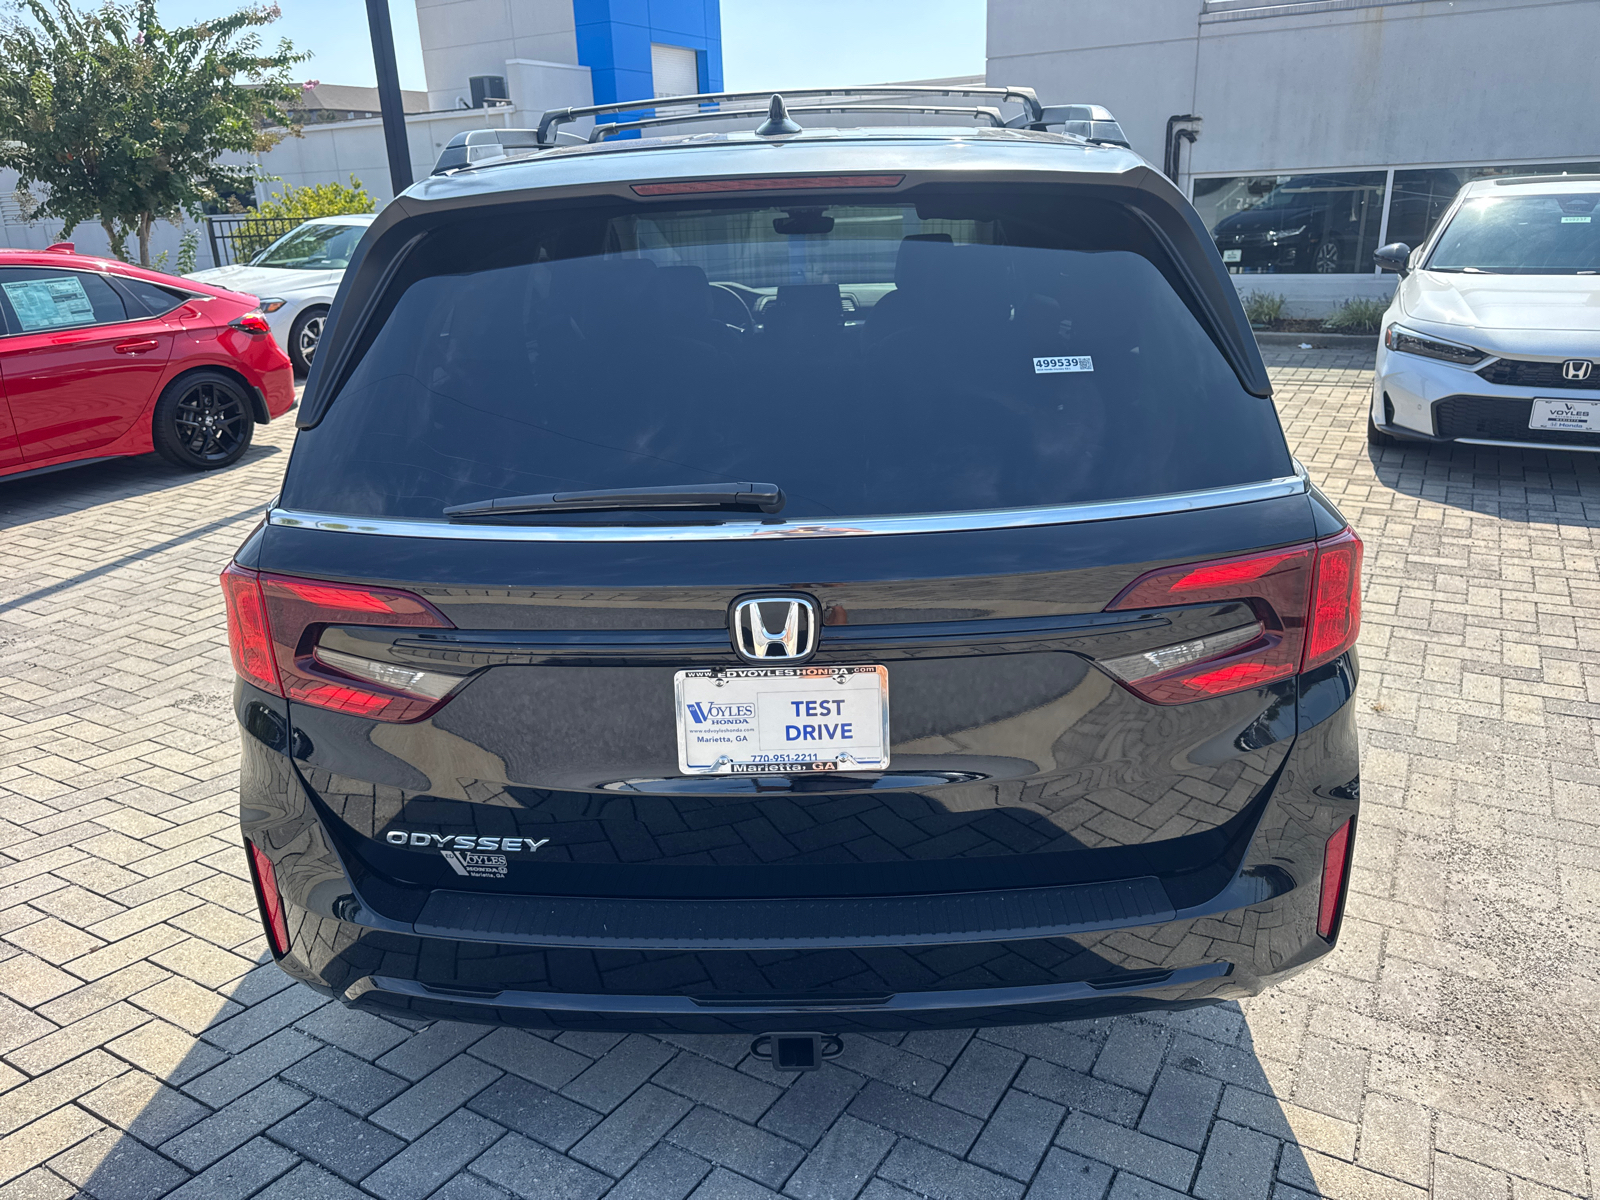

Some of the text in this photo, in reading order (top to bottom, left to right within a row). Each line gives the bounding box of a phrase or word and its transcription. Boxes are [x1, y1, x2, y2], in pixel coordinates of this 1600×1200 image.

[1035, 358, 1079, 368] 499539
[695, 702, 753, 722] VOYLES
[791, 700, 845, 717] TEST
[786, 723, 853, 742] DRIVE
[751, 754, 818, 762] 770-951-2211
[733, 762, 836, 772] Marietta, GA
[386, 830, 550, 852] ODYSSEY
[454, 851, 506, 866] VOYLES
